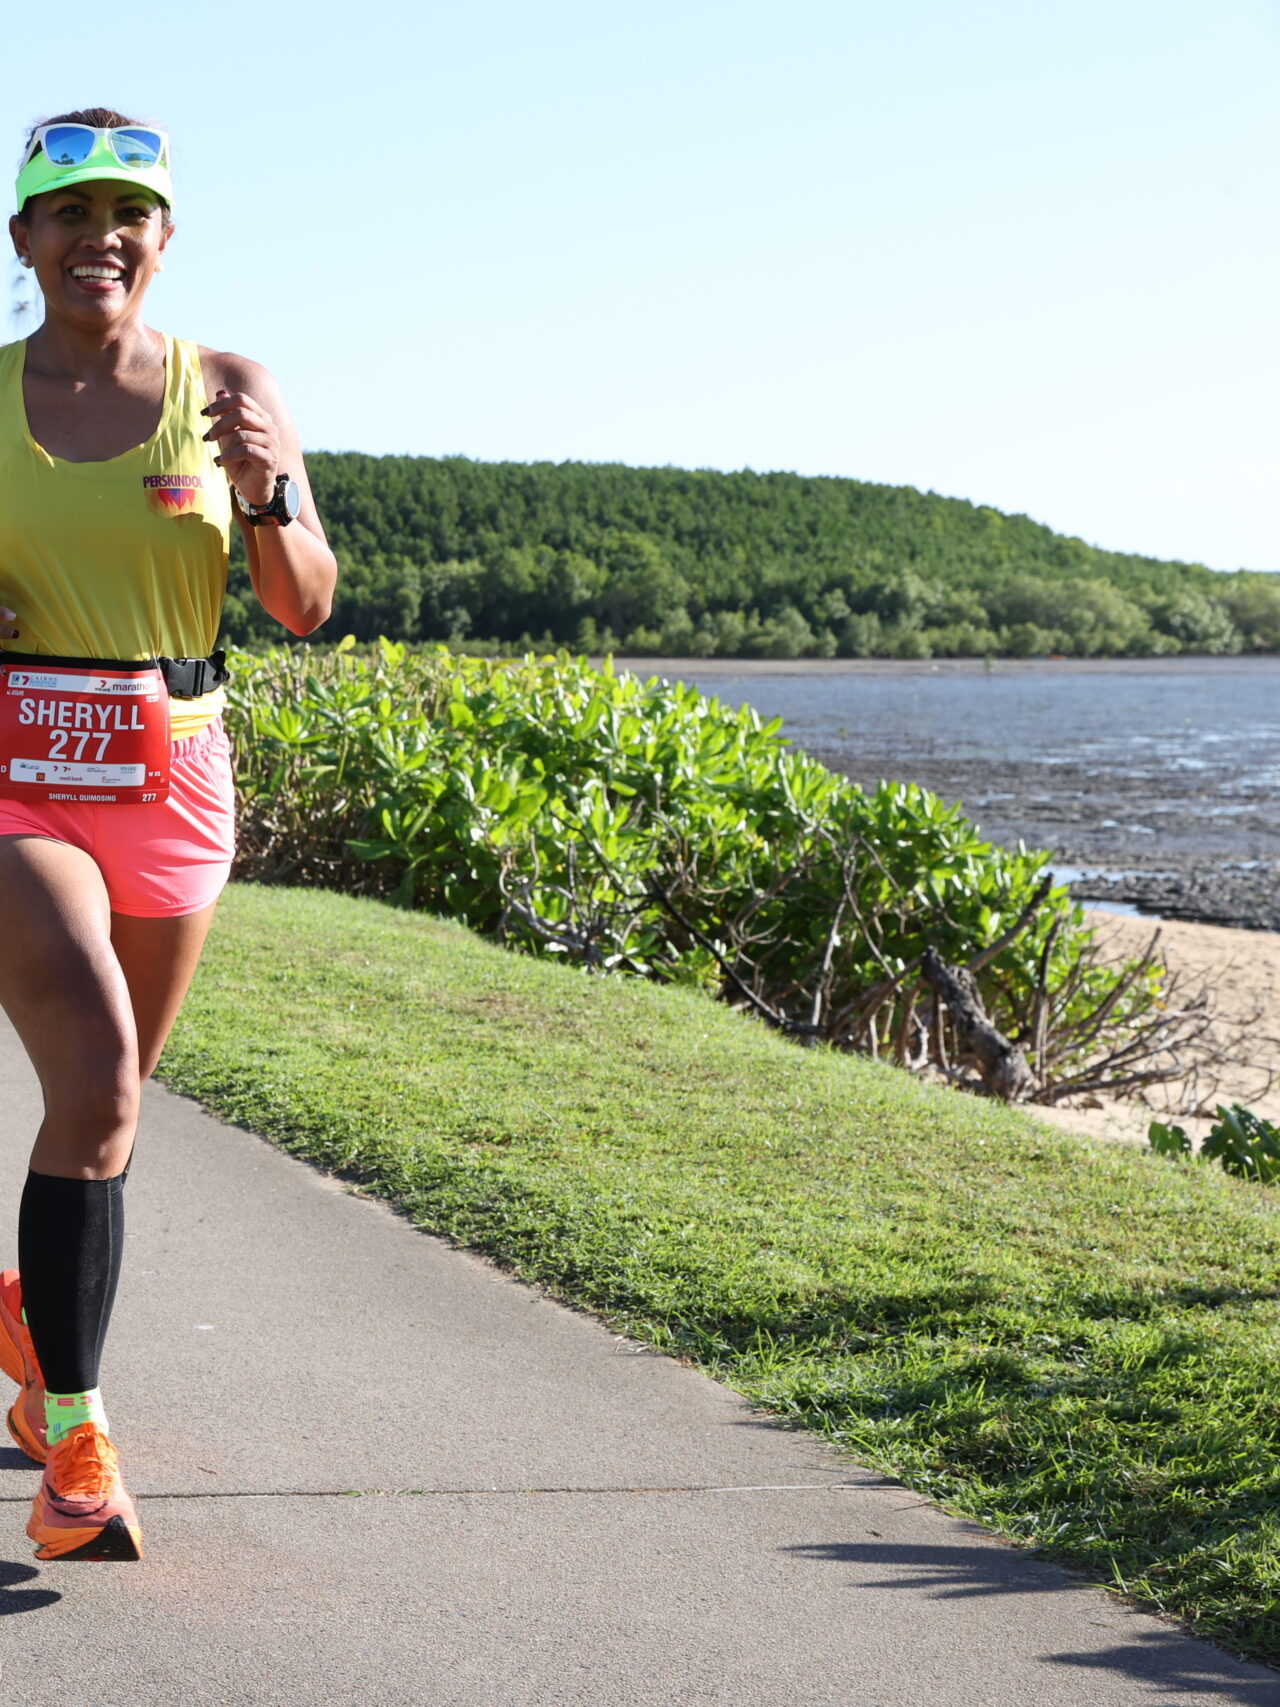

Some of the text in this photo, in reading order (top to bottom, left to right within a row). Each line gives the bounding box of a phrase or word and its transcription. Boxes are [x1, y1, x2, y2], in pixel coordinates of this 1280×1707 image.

[142, 474, 203, 489] PERSKINDOL
[19, 699, 145, 729] SHERYLL
[48, 730, 112, 761] 277
[48, 792, 117, 802] SHERYLL QUIMOSING
[141, 793, 157, 802] 277
